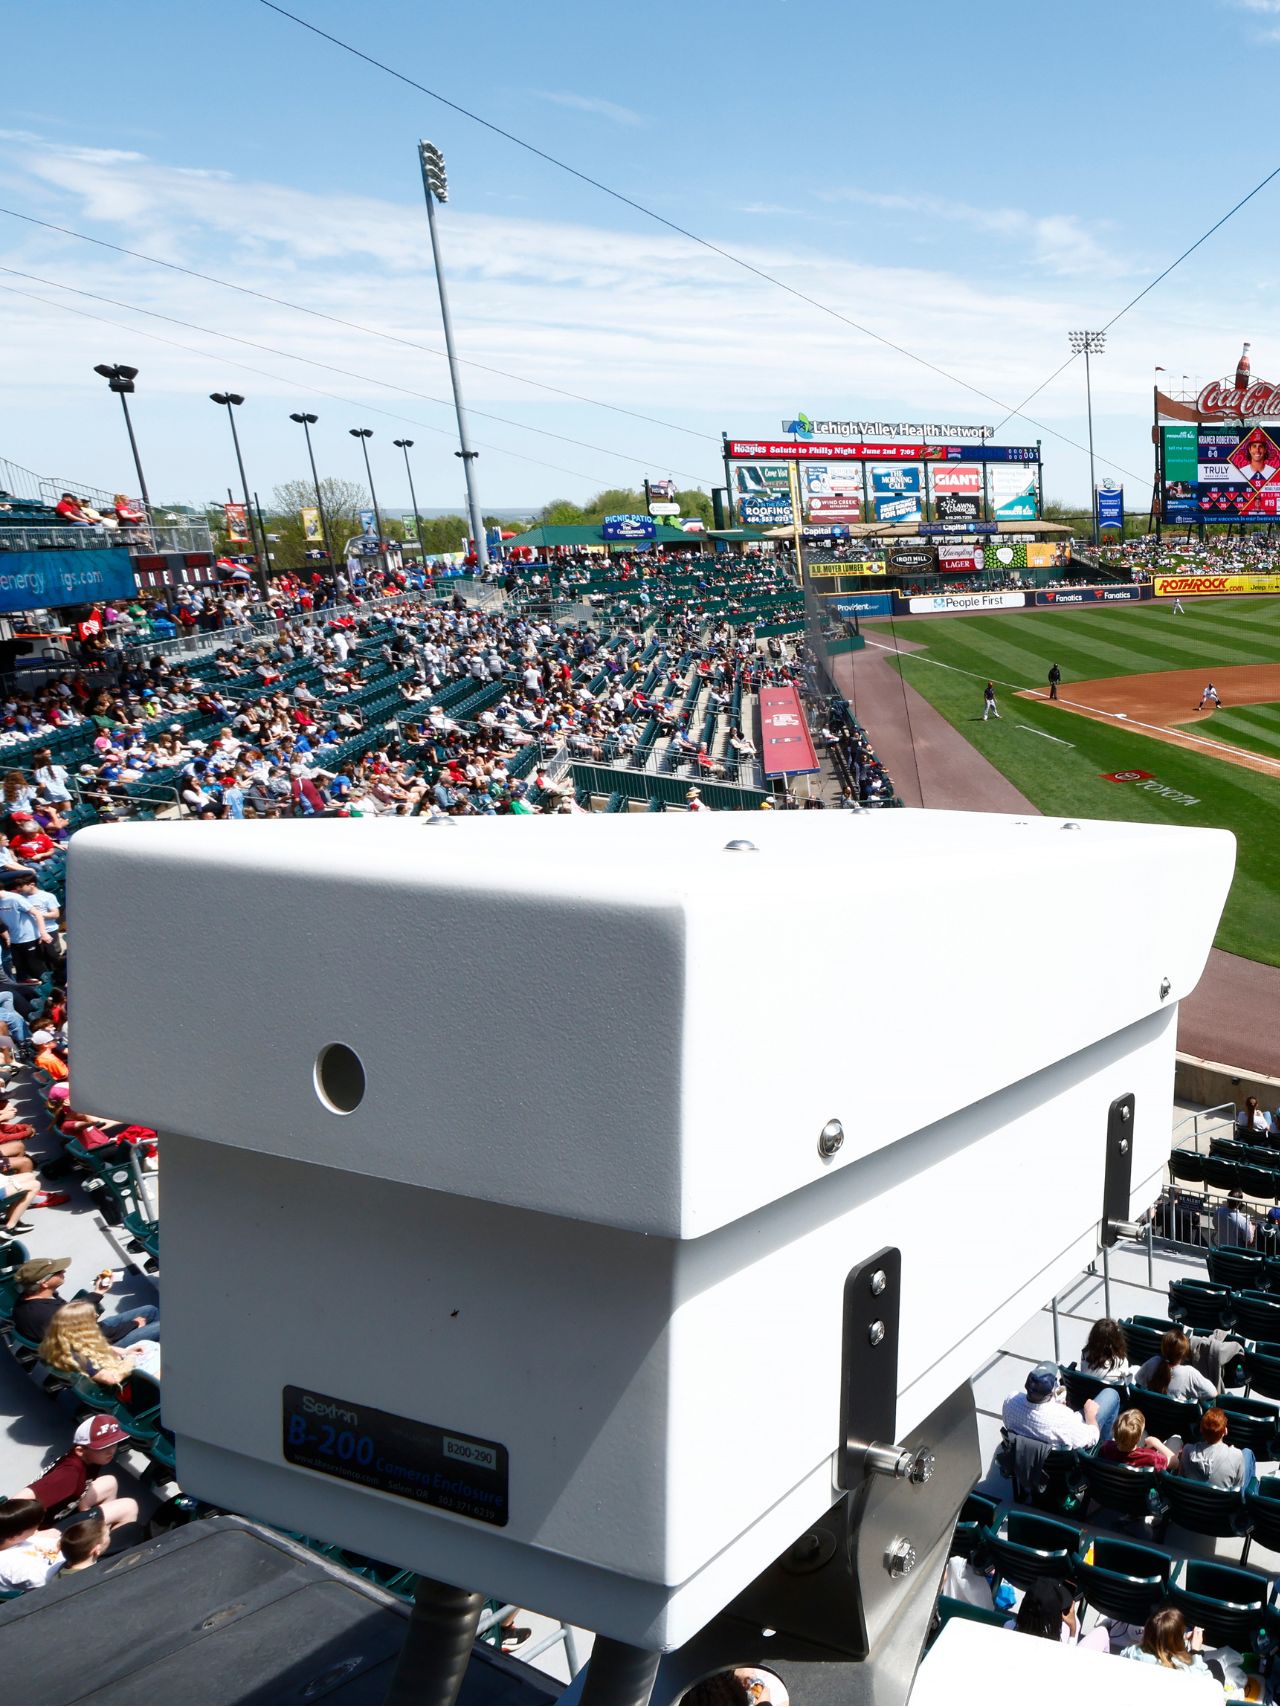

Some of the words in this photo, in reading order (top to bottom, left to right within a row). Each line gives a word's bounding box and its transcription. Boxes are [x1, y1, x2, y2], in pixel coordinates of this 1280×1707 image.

[813, 421, 858, 437] Lehigh
[859, 422, 898, 438] Valley
[900, 423, 940, 436] Health
[941, 425, 991, 437] Network
[770, 446, 797, 454] Salute
[809, 446, 833, 455] Philly
[834, 447, 856, 455] Night
[1204, 466, 1230, 474] TRULY
[882, 476, 912, 484] MORNING
[936, 474, 977, 486] GIANT
[745, 506, 791, 515] ROOFING
[605, 514, 630, 524] PICNIC
[631, 515, 652, 523] PATIO
[803, 527, 831, 536] Capital
[943, 523, 967, 531] Capital
[822, 564, 842, 573] MOYER
[843, 563, 864, 572] LUMBER
[945, 560, 971, 568] LAGER
[0, 570, 44, 594] energy
[60, 567, 102, 592] igs.com
[134, 573, 142, 588] R
[149, 572, 156, 587] H
[163, 571, 170, 585] E
[181, 569, 189, 583] R
[194, 569, 201, 581] H
[206, 568, 213, 580] E
[1056, 594, 1083, 602] Fanatics
[1104, 591, 1131, 599] Fanatics
[838, 603, 869, 611] Provident
[946, 597, 979, 609] People
[982, 596, 1003, 605] First
[1136, 780, 1202, 806] TOYOTA
[302, 1395, 358, 1426] Sexton
[288, 1412, 375, 1467] B-200
[447, 1442, 494, 1464] B200-290
[375, 1455, 431, 1487] Camera
[433, 1471, 504, 1506] Enclosure
